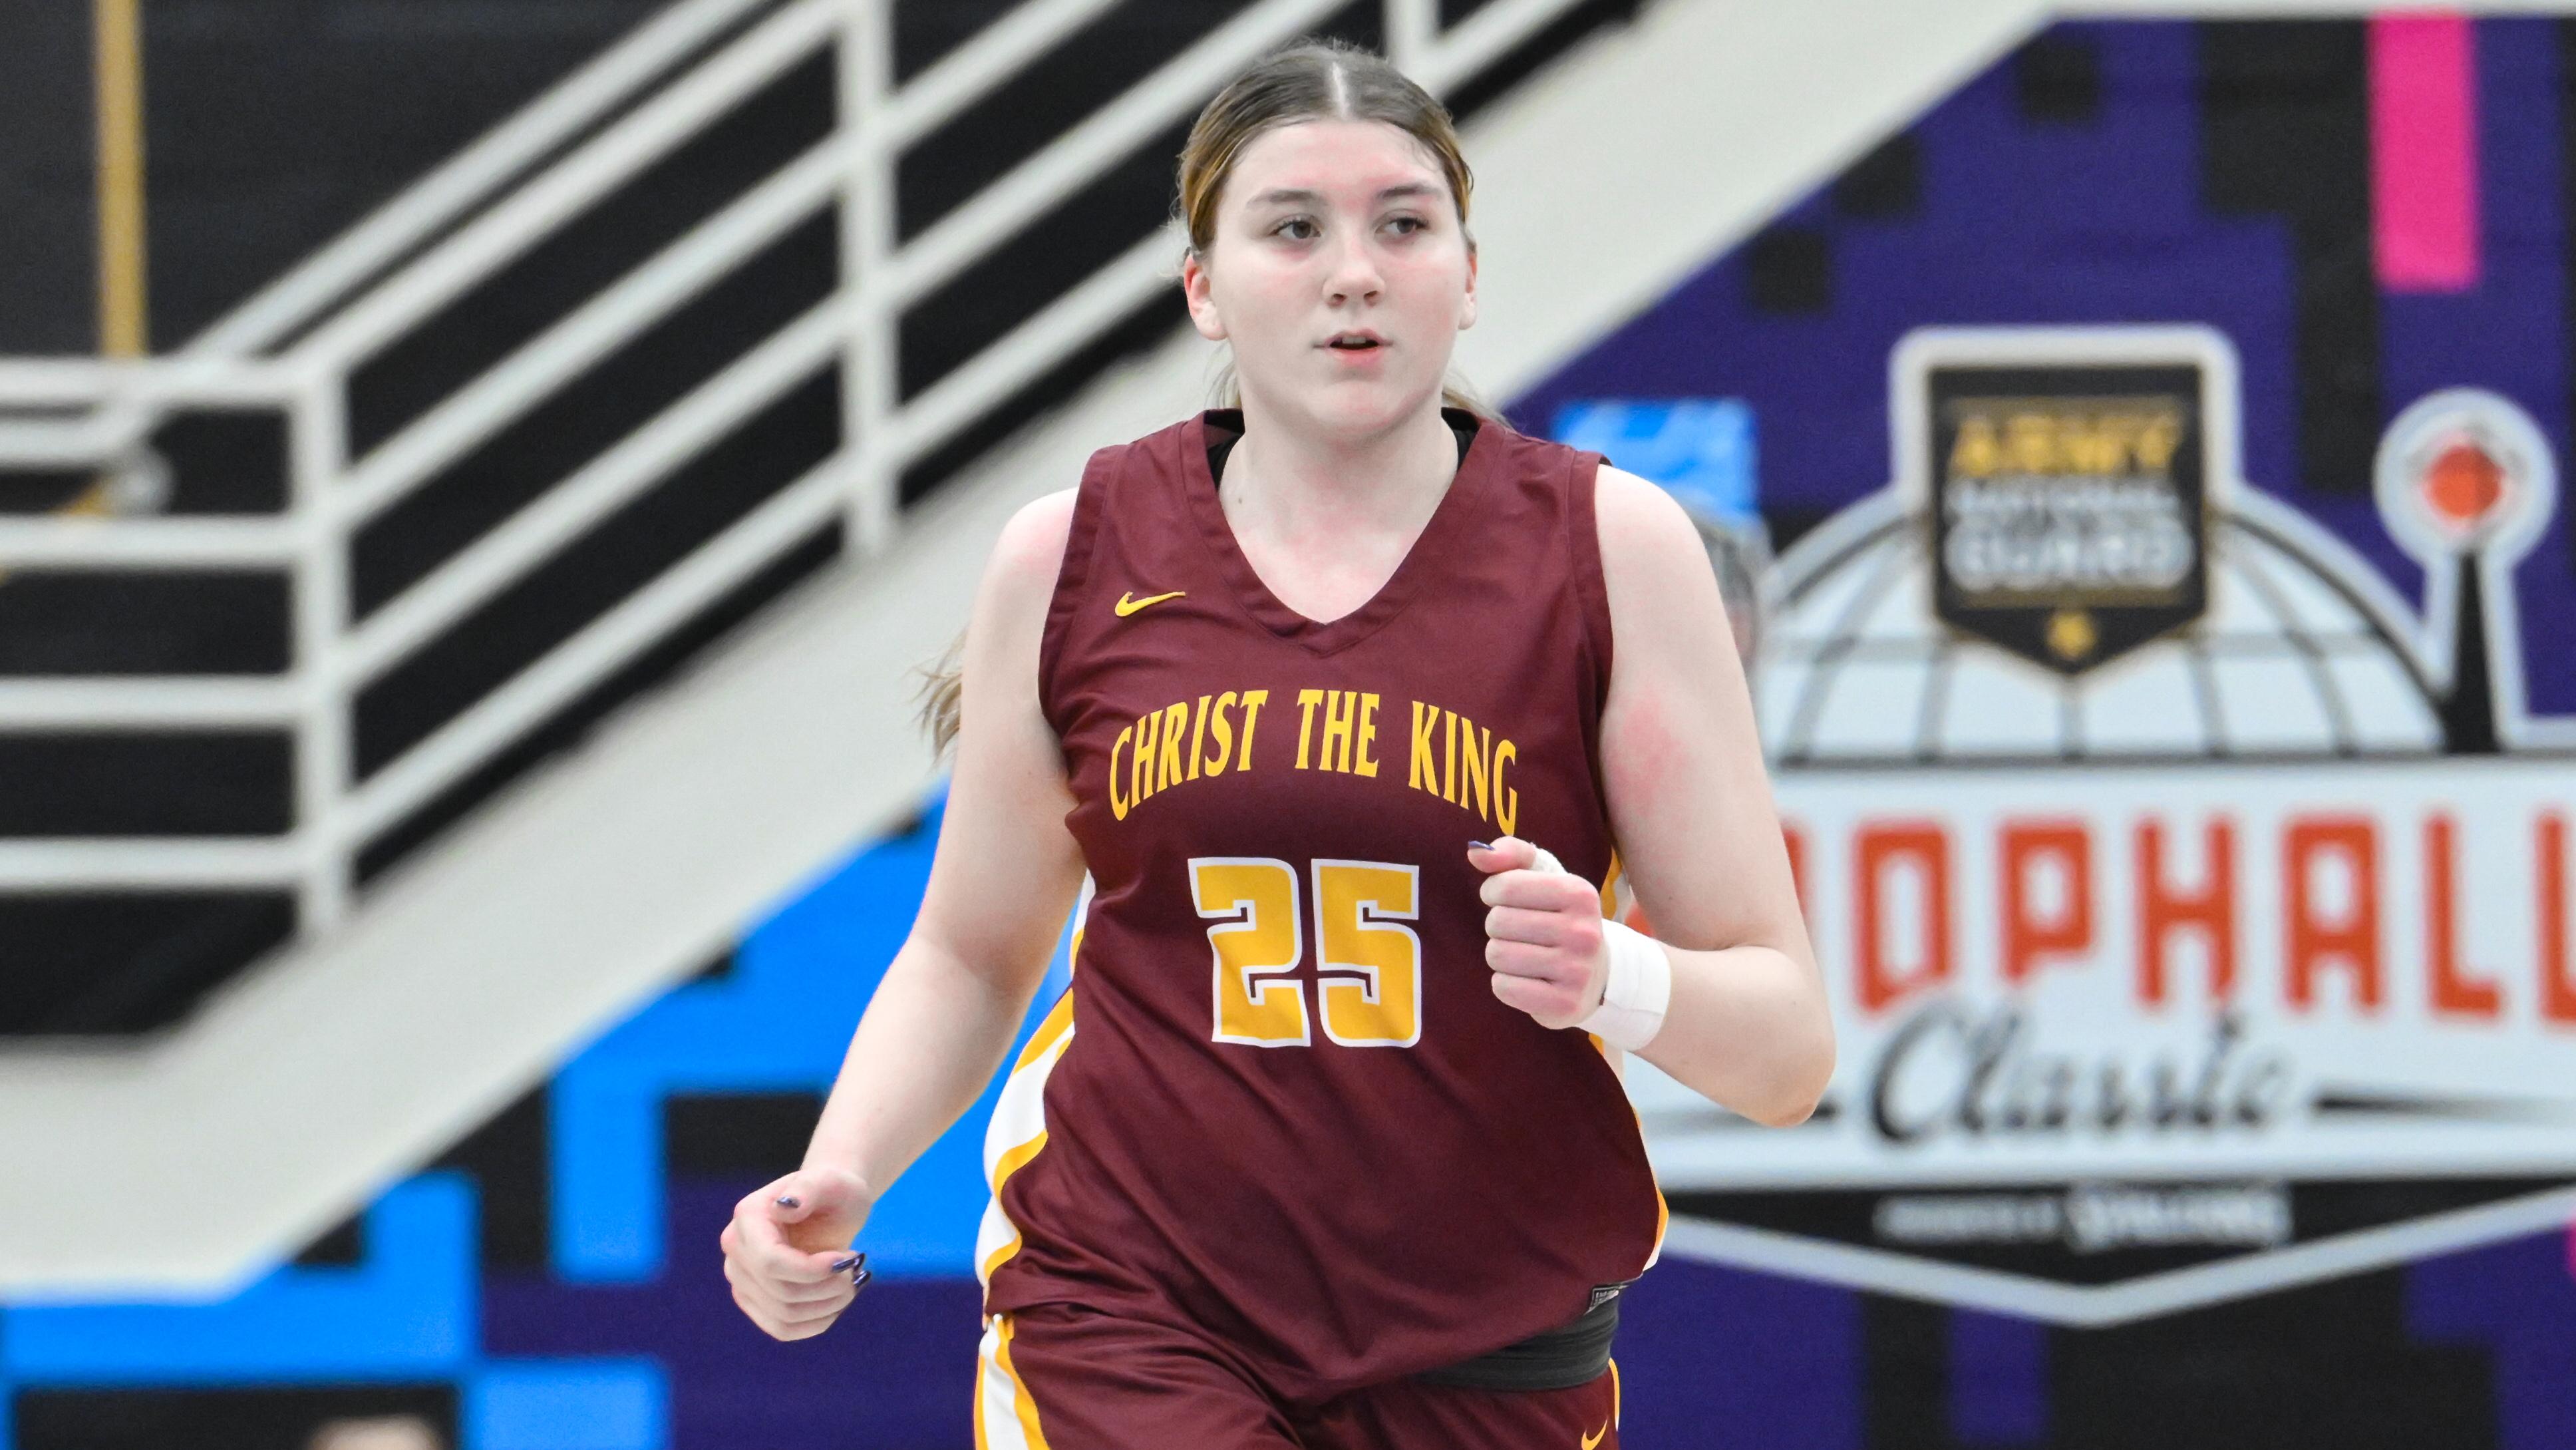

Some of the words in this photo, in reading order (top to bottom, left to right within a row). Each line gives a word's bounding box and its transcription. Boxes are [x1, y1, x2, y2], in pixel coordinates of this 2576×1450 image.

[1109, 689, 1269, 821] CHRIST
[1295, 689, 1380, 778] THE
[1408, 700, 1518, 837] KING
[1188, 856, 1422, 1048] 25
[1627, 811, 2576, 1023] OPHALL
[1871, 1001, 2295, 1145] Classic
